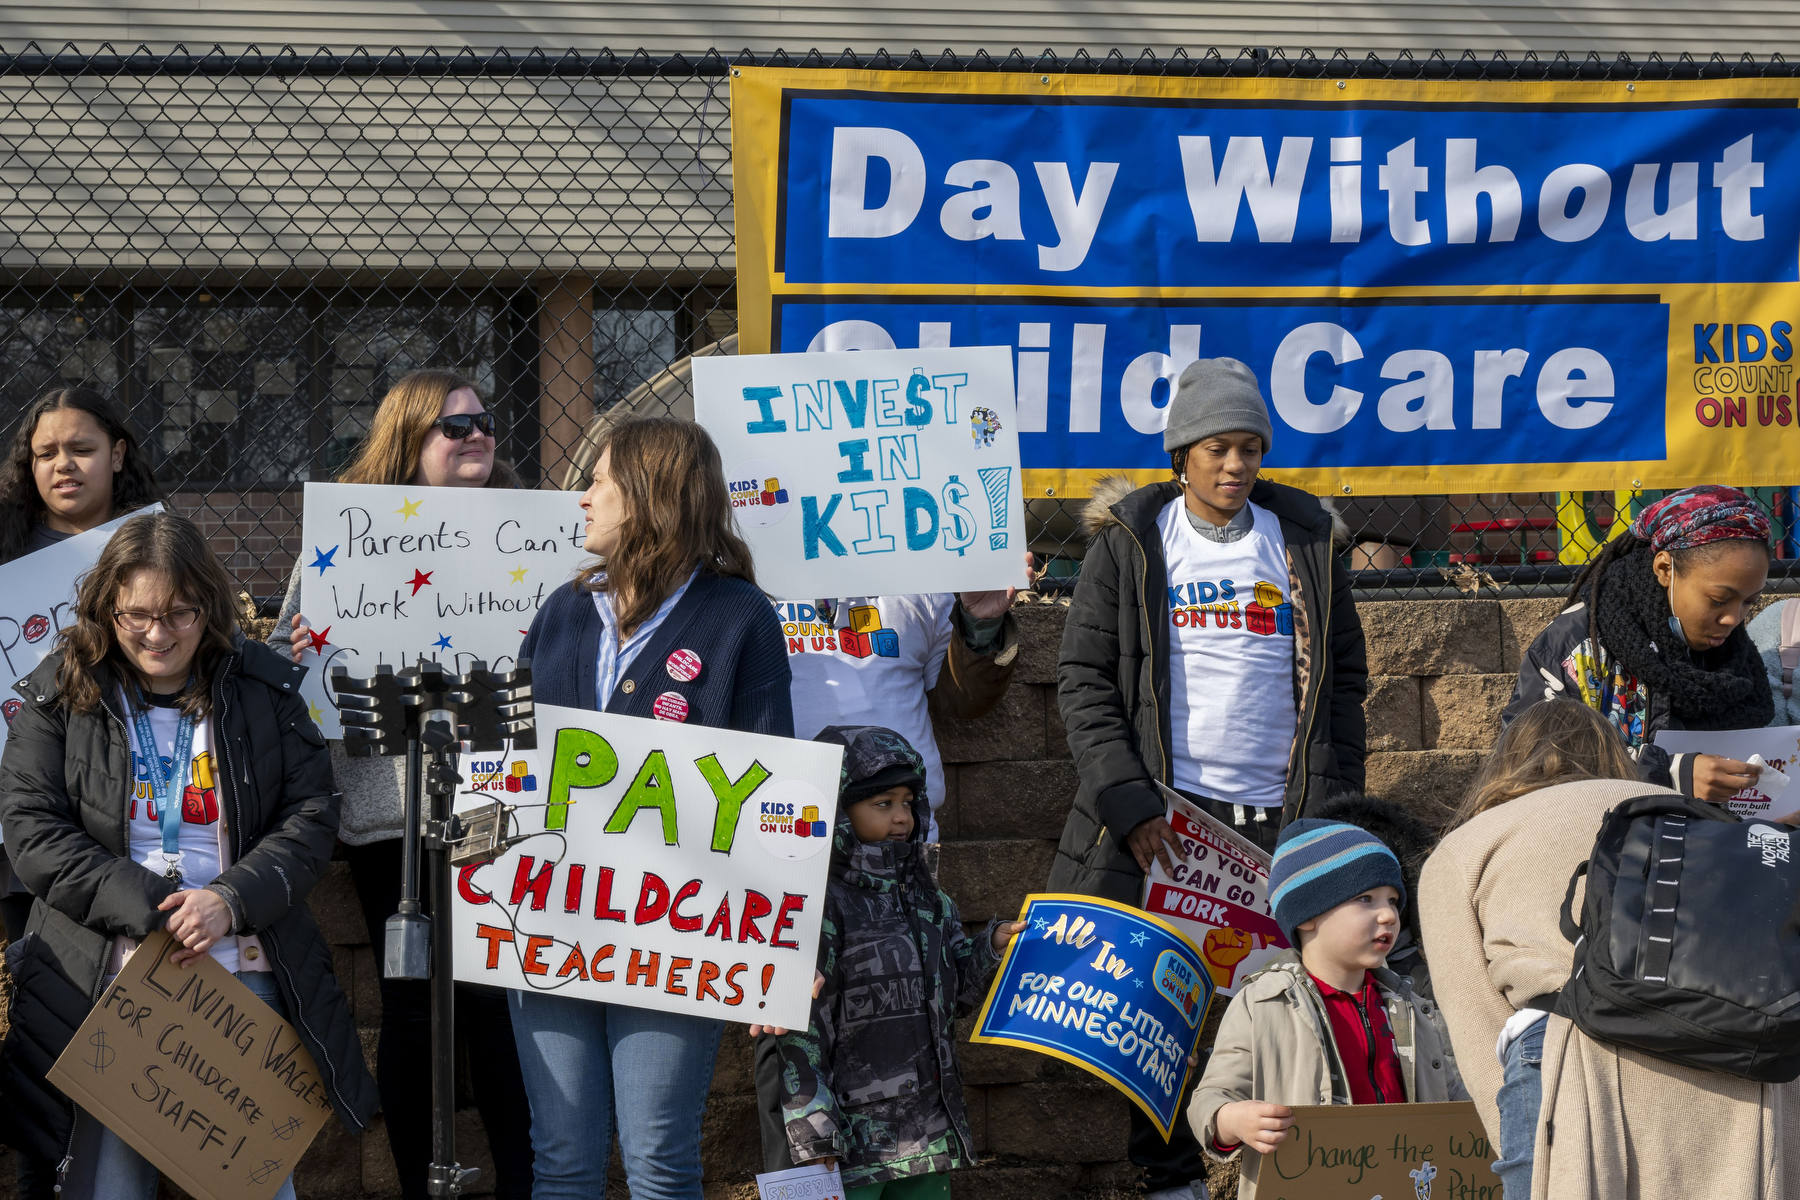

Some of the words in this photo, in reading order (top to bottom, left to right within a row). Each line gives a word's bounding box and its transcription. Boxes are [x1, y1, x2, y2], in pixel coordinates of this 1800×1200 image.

[828, 126, 1120, 272] Day
[1178, 133, 1765, 246] Without
[1693, 321, 1793, 363] KIDS
[805, 319, 1201, 435] ild
[1270, 322, 1616, 434] Care
[1693, 365, 1792, 394] COUNT
[1695, 395, 1747, 428] ON
[1757, 394, 1792, 427] US
[837, 433, 921, 484] IN
[729, 479, 758, 492] KIDS
[730, 490, 759, 499] COUNT
[732, 499, 747, 507] ON
[749, 497, 760, 505] US
[340, 507, 472, 557] Parents
[496, 519, 587, 553] Can't
[332, 583, 409, 620] Work
[437, 582, 544, 617] Without
[1167, 579, 1236, 608] KIDS
[783, 623, 835, 637] OUNT
[1172, 611, 1206, 628] ON
[1215, 611, 1242, 629] US
[785, 638, 805, 654] N
[811, 636, 837, 651] US
[471, 760, 504, 773] KIDS
[471, 773, 504, 783] COUNT
[472, 782, 489, 791] ON
[491, 781, 505, 791] US
[544, 727, 774, 857] PAY
[760, 814, 794, 824] COUNT
[761, 802, 794, 815] KIDS
[1749, 802, 1770, 810] built
[760, 824, 777, 832] ON
[780, 824, 793, 833] US
[1747, 832, 1761, 848] THE
[1183, 839, 1208, 861] SO
[1217, 854, 1257, 884] YOU
[1186, 821, 1270, 877] CHILDCA
[1776, 837, 1790, 863] FACE
[1173, 864, 1221, 894] CAN
[1226, 885, 1255, 906] GO
[457, 855, 808, 950] CHILDCARE
[1163, 889, 1230, 927] WORK.
[1043, 914, 1096, 949] All
[1090, 940, 1134, 980] In
[475, 923, 775, 1009] TEACHERS!
[1165, 969, 1188, 993] COUNT
[1168, 956, 1192, 985] KIDS
[140, 935, 257, 1056] LIVING
[1162, 978, 1176, 994] ON
[1176, 988, 1185, 1003] US
[1018, 972, 1065, 994] FOR
[1067, 980, 1118, 1014] OUR
[1120, 1002, 1185, 1070] LITTLEST
[101, 984, 152, 1038] FOR
[155, 1024, 264, 1125] CHILDCARE
[1008, 993, 1177, 1096] MINNESOTANS
[131, 1064, 247, 1170] STAFF!
[1274, 1124, 1380, 1185] Change
[1386, 1134, 1434, 1162] the
